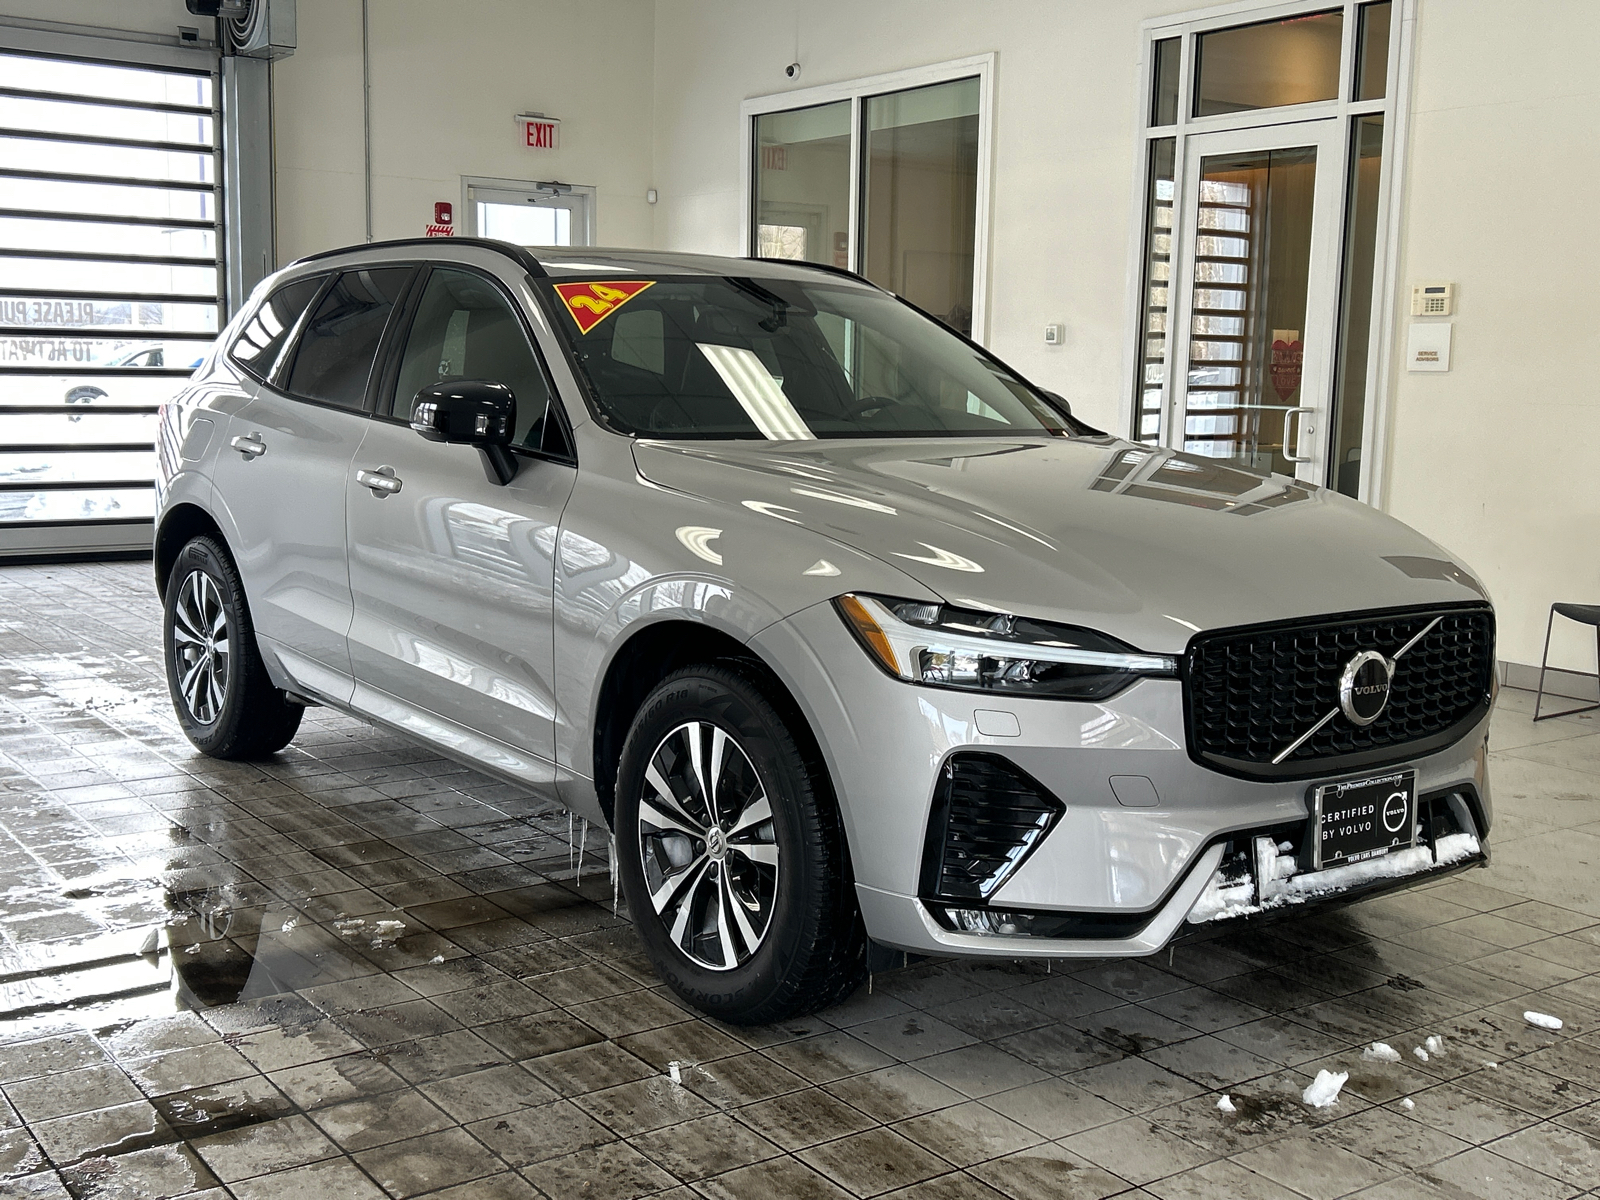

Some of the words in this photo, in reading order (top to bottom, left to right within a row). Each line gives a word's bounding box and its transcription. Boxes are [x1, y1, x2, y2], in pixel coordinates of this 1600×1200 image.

[526, 121, 555, 149] EXIT
[568, 283, 629, 315] 24
[1354, 683, 1388, 696] VOLVO
[1321, 804, 1375, 824] CERTIFIED
[1386, 808, 1405, 817] VOLVO
[1322, 829, 1335, 841] BY
[1339, 821, 1372, 837] VOLVO
[1347, 855, 1360, 863] VOLVO
[1360, 852, 1371, 860] CARS
